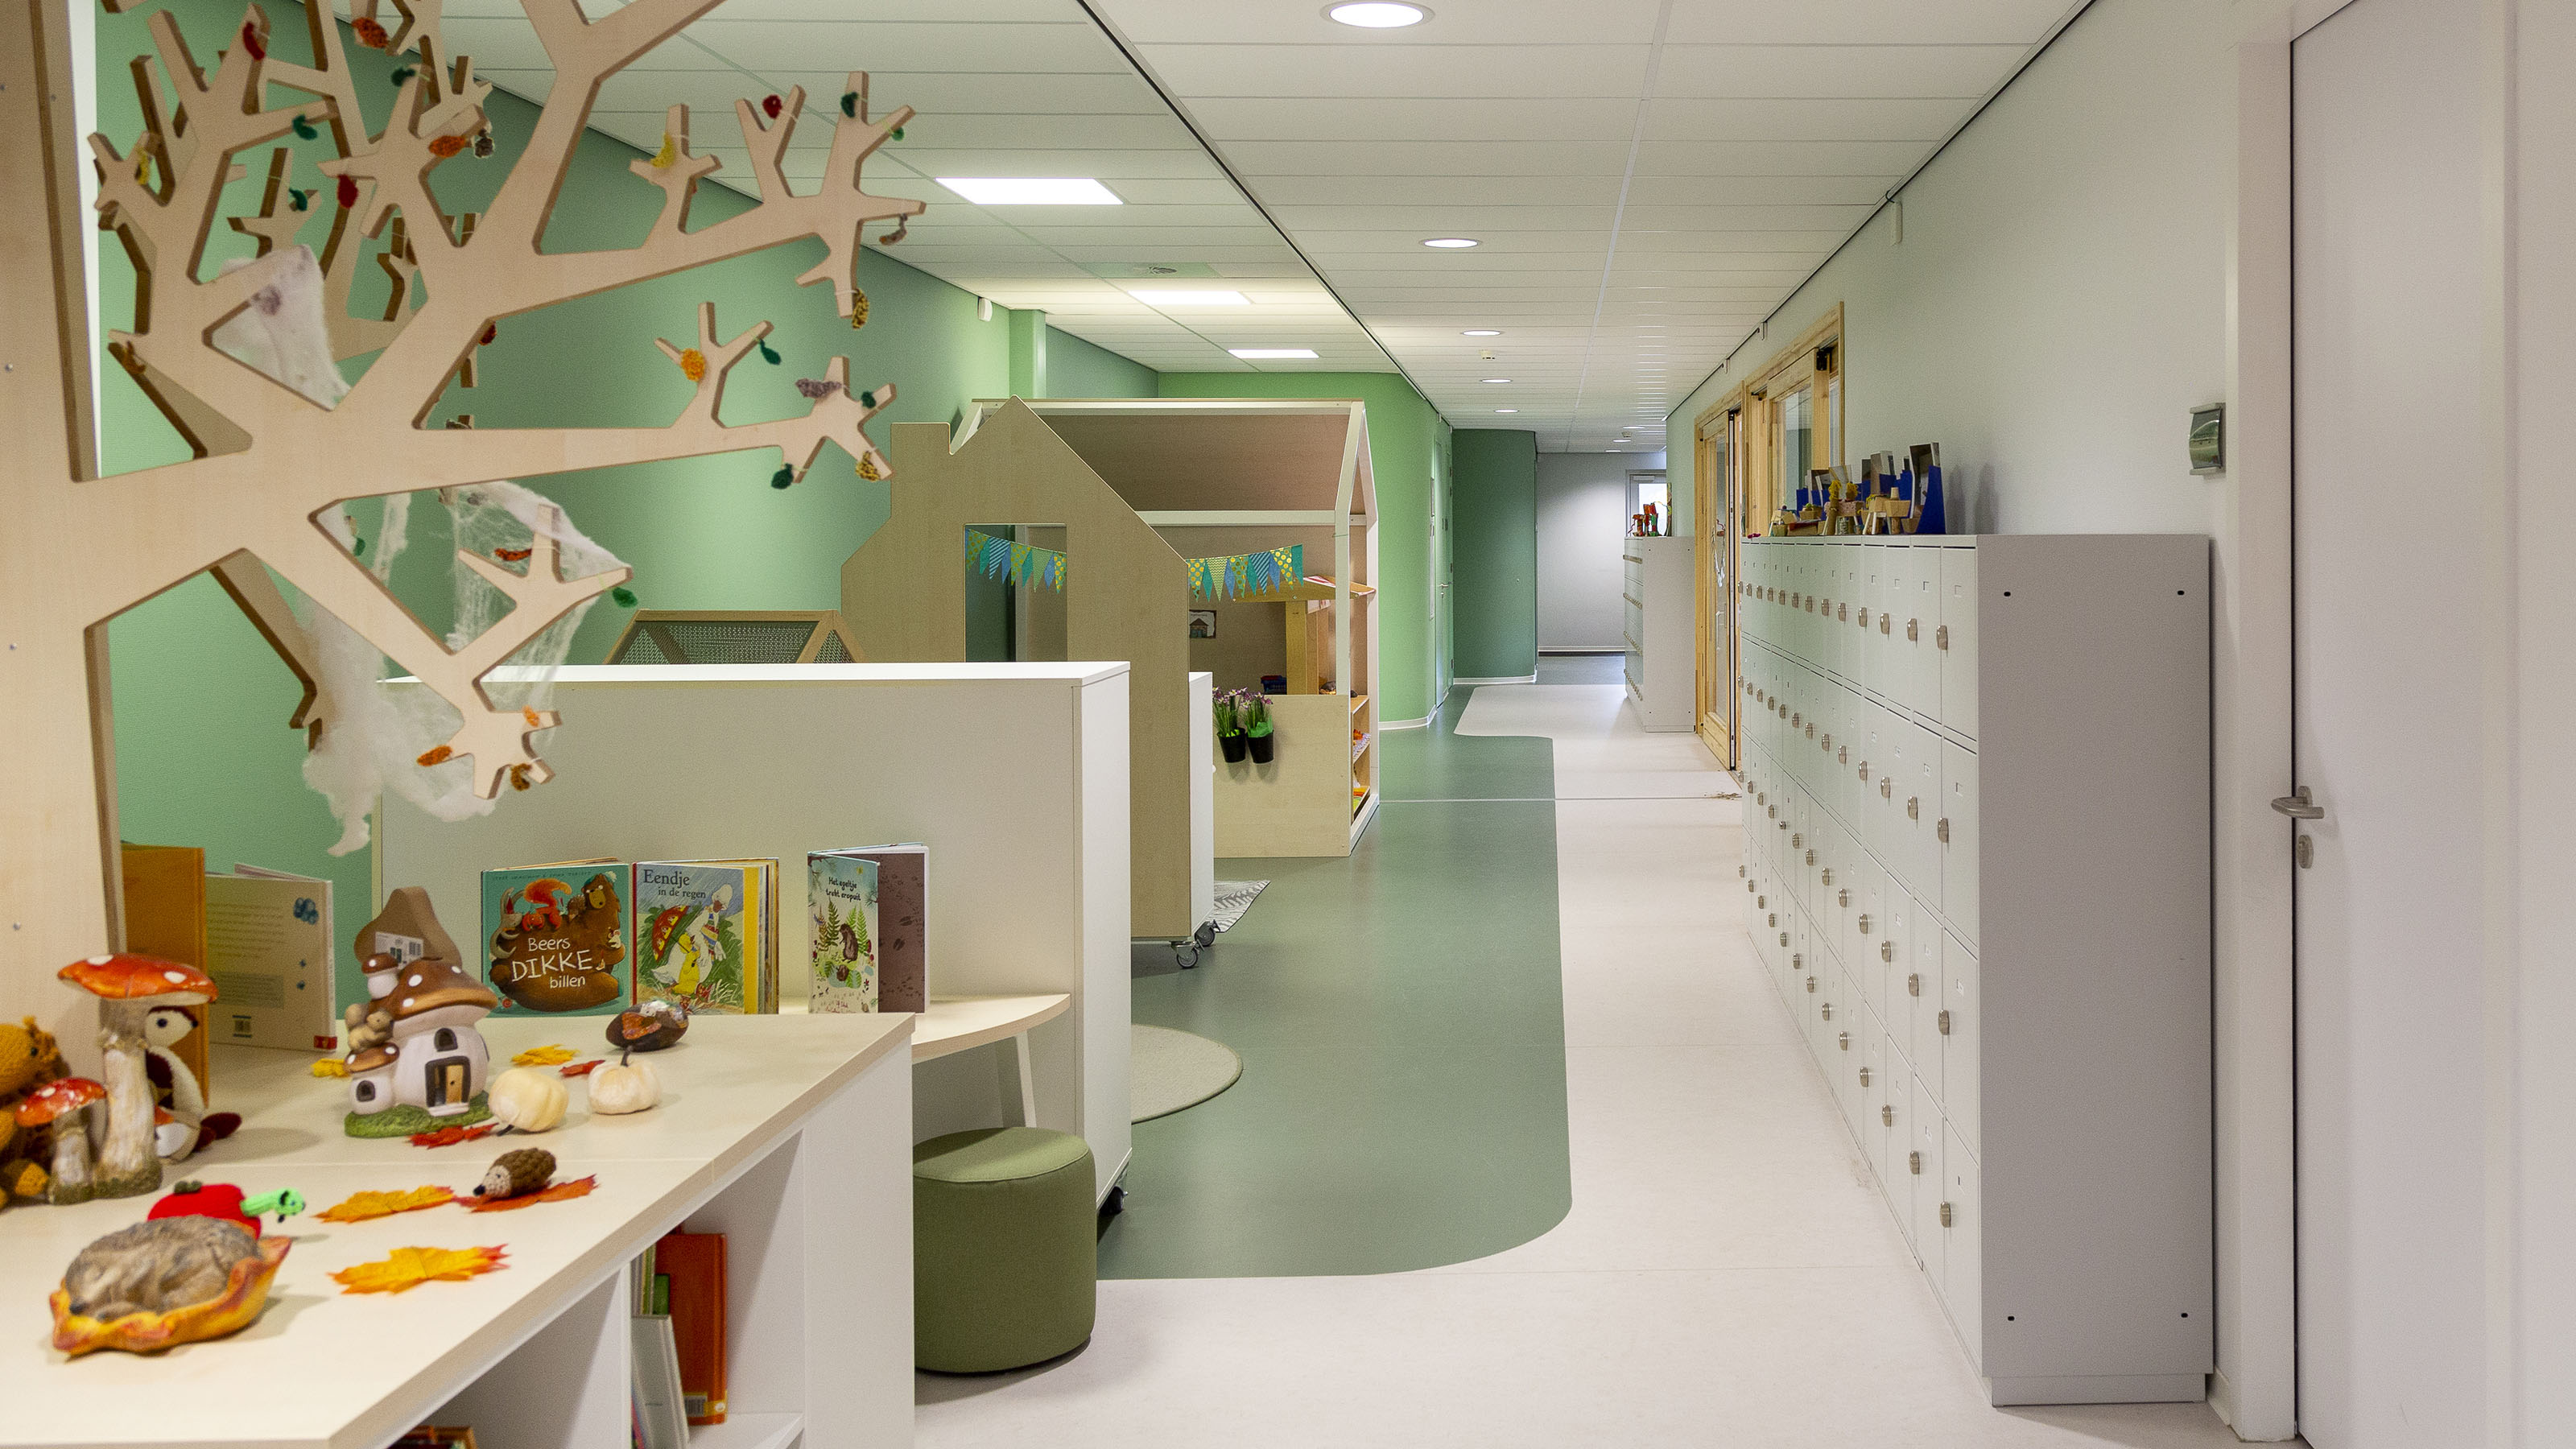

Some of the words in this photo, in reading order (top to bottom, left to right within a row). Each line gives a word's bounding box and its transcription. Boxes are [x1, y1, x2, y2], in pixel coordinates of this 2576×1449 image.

[643, 869, 690, 889] Eendje
[828, 877, 839, 886] Het
[658, 886, 667, 896] in
[669, 887, 679, 897] de
[682, 890, 706, 900] regen
[528, 937, 571, 952] Beers
[511, 949, 592, 982] DIKKE
[550, 975, 586, 989] billen
